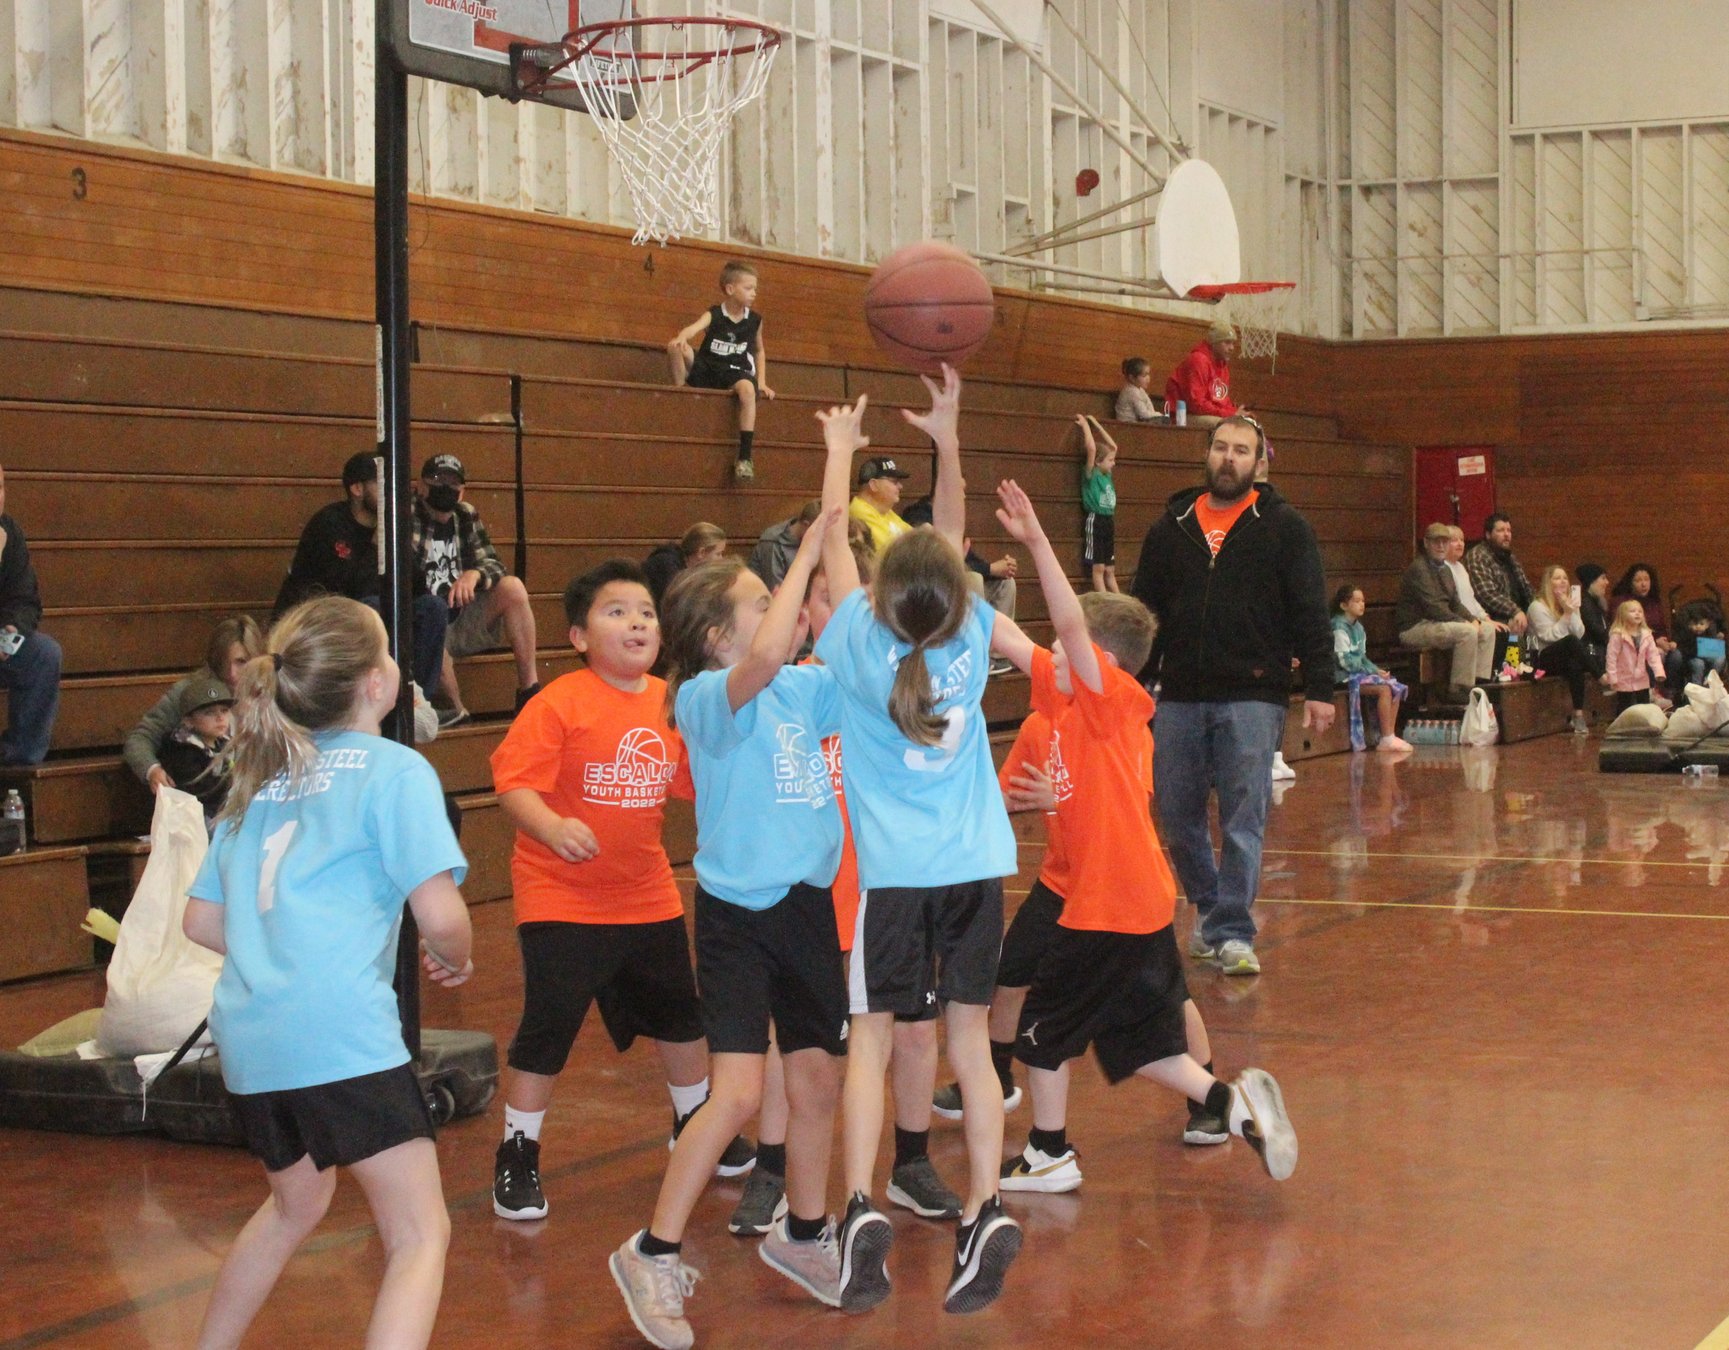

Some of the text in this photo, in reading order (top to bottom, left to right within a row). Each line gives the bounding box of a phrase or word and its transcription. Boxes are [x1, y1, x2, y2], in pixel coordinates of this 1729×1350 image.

[459, 0, 498, 21] Adjust
[71, 167, 87, 200] 3
[643, 252, 655, 278] 4
[316, 748, 369, 769] STEEL
[583, 784, 621, 797] YOUTH
[621, 798, 656, 808] 2022
[256, 819, 299, 916] 1
